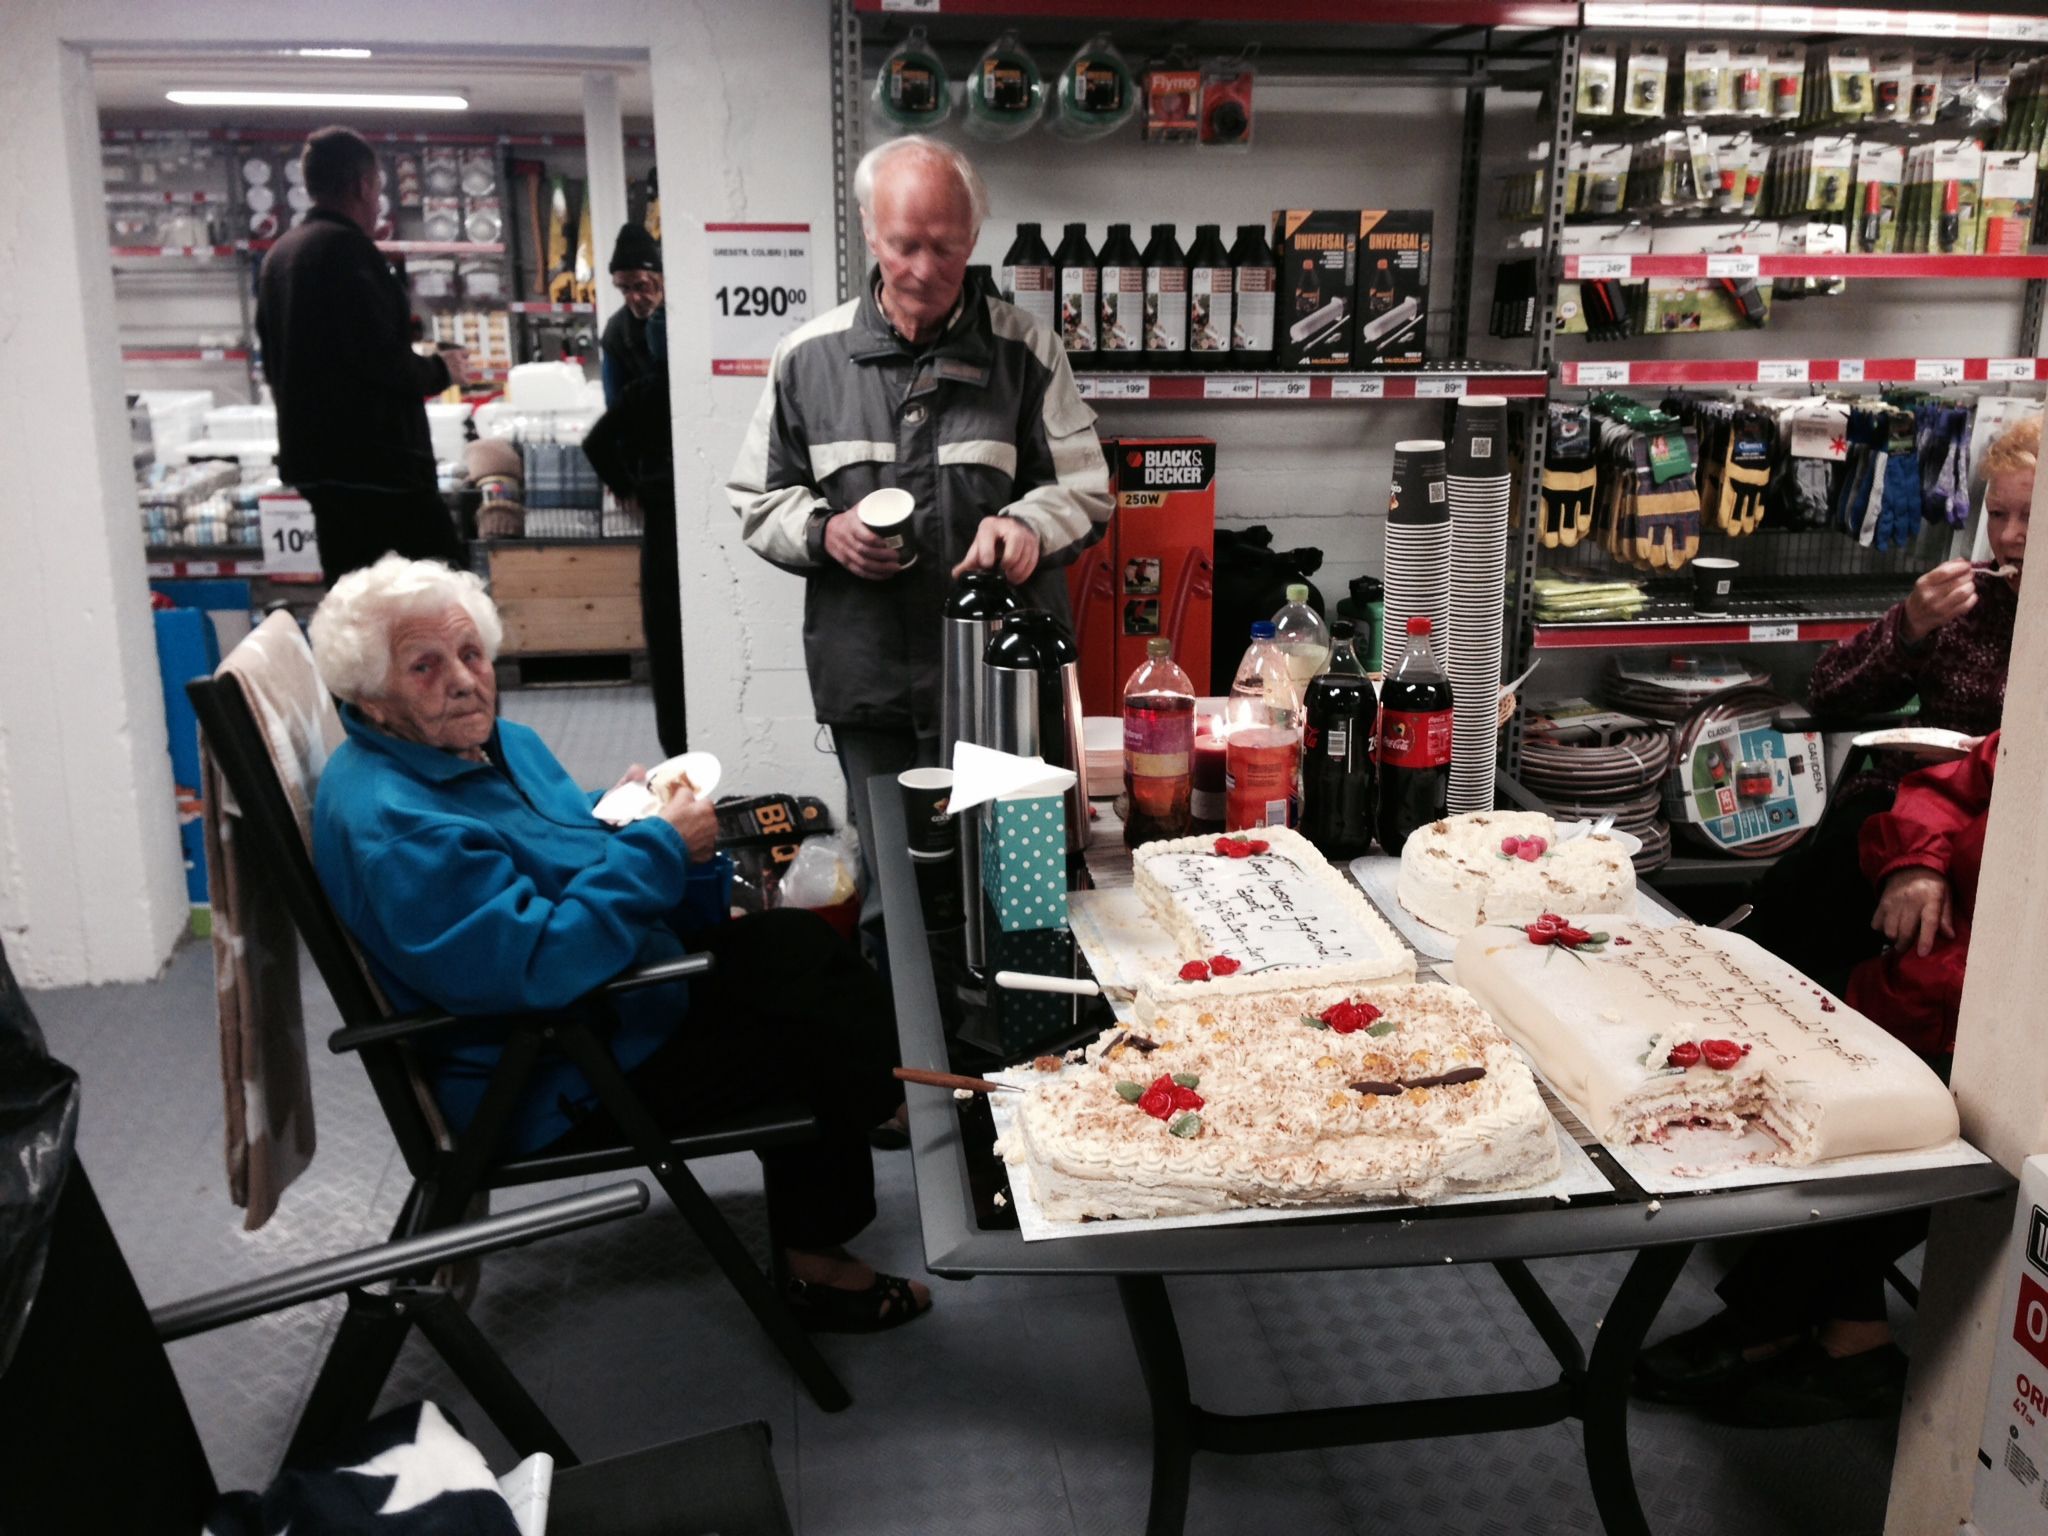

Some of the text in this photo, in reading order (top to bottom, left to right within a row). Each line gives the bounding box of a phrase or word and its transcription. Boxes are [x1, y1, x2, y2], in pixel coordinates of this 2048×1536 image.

[1151, 75, 1197, 93] Flymo
[1294, 233, 1345, 250] UNIVERSAL
[1369, 233, 1420, 250] UNIVERSAL
[1145, 467, 1201, 484] DECKER
[1125, 494, 1160, 505] 250W
